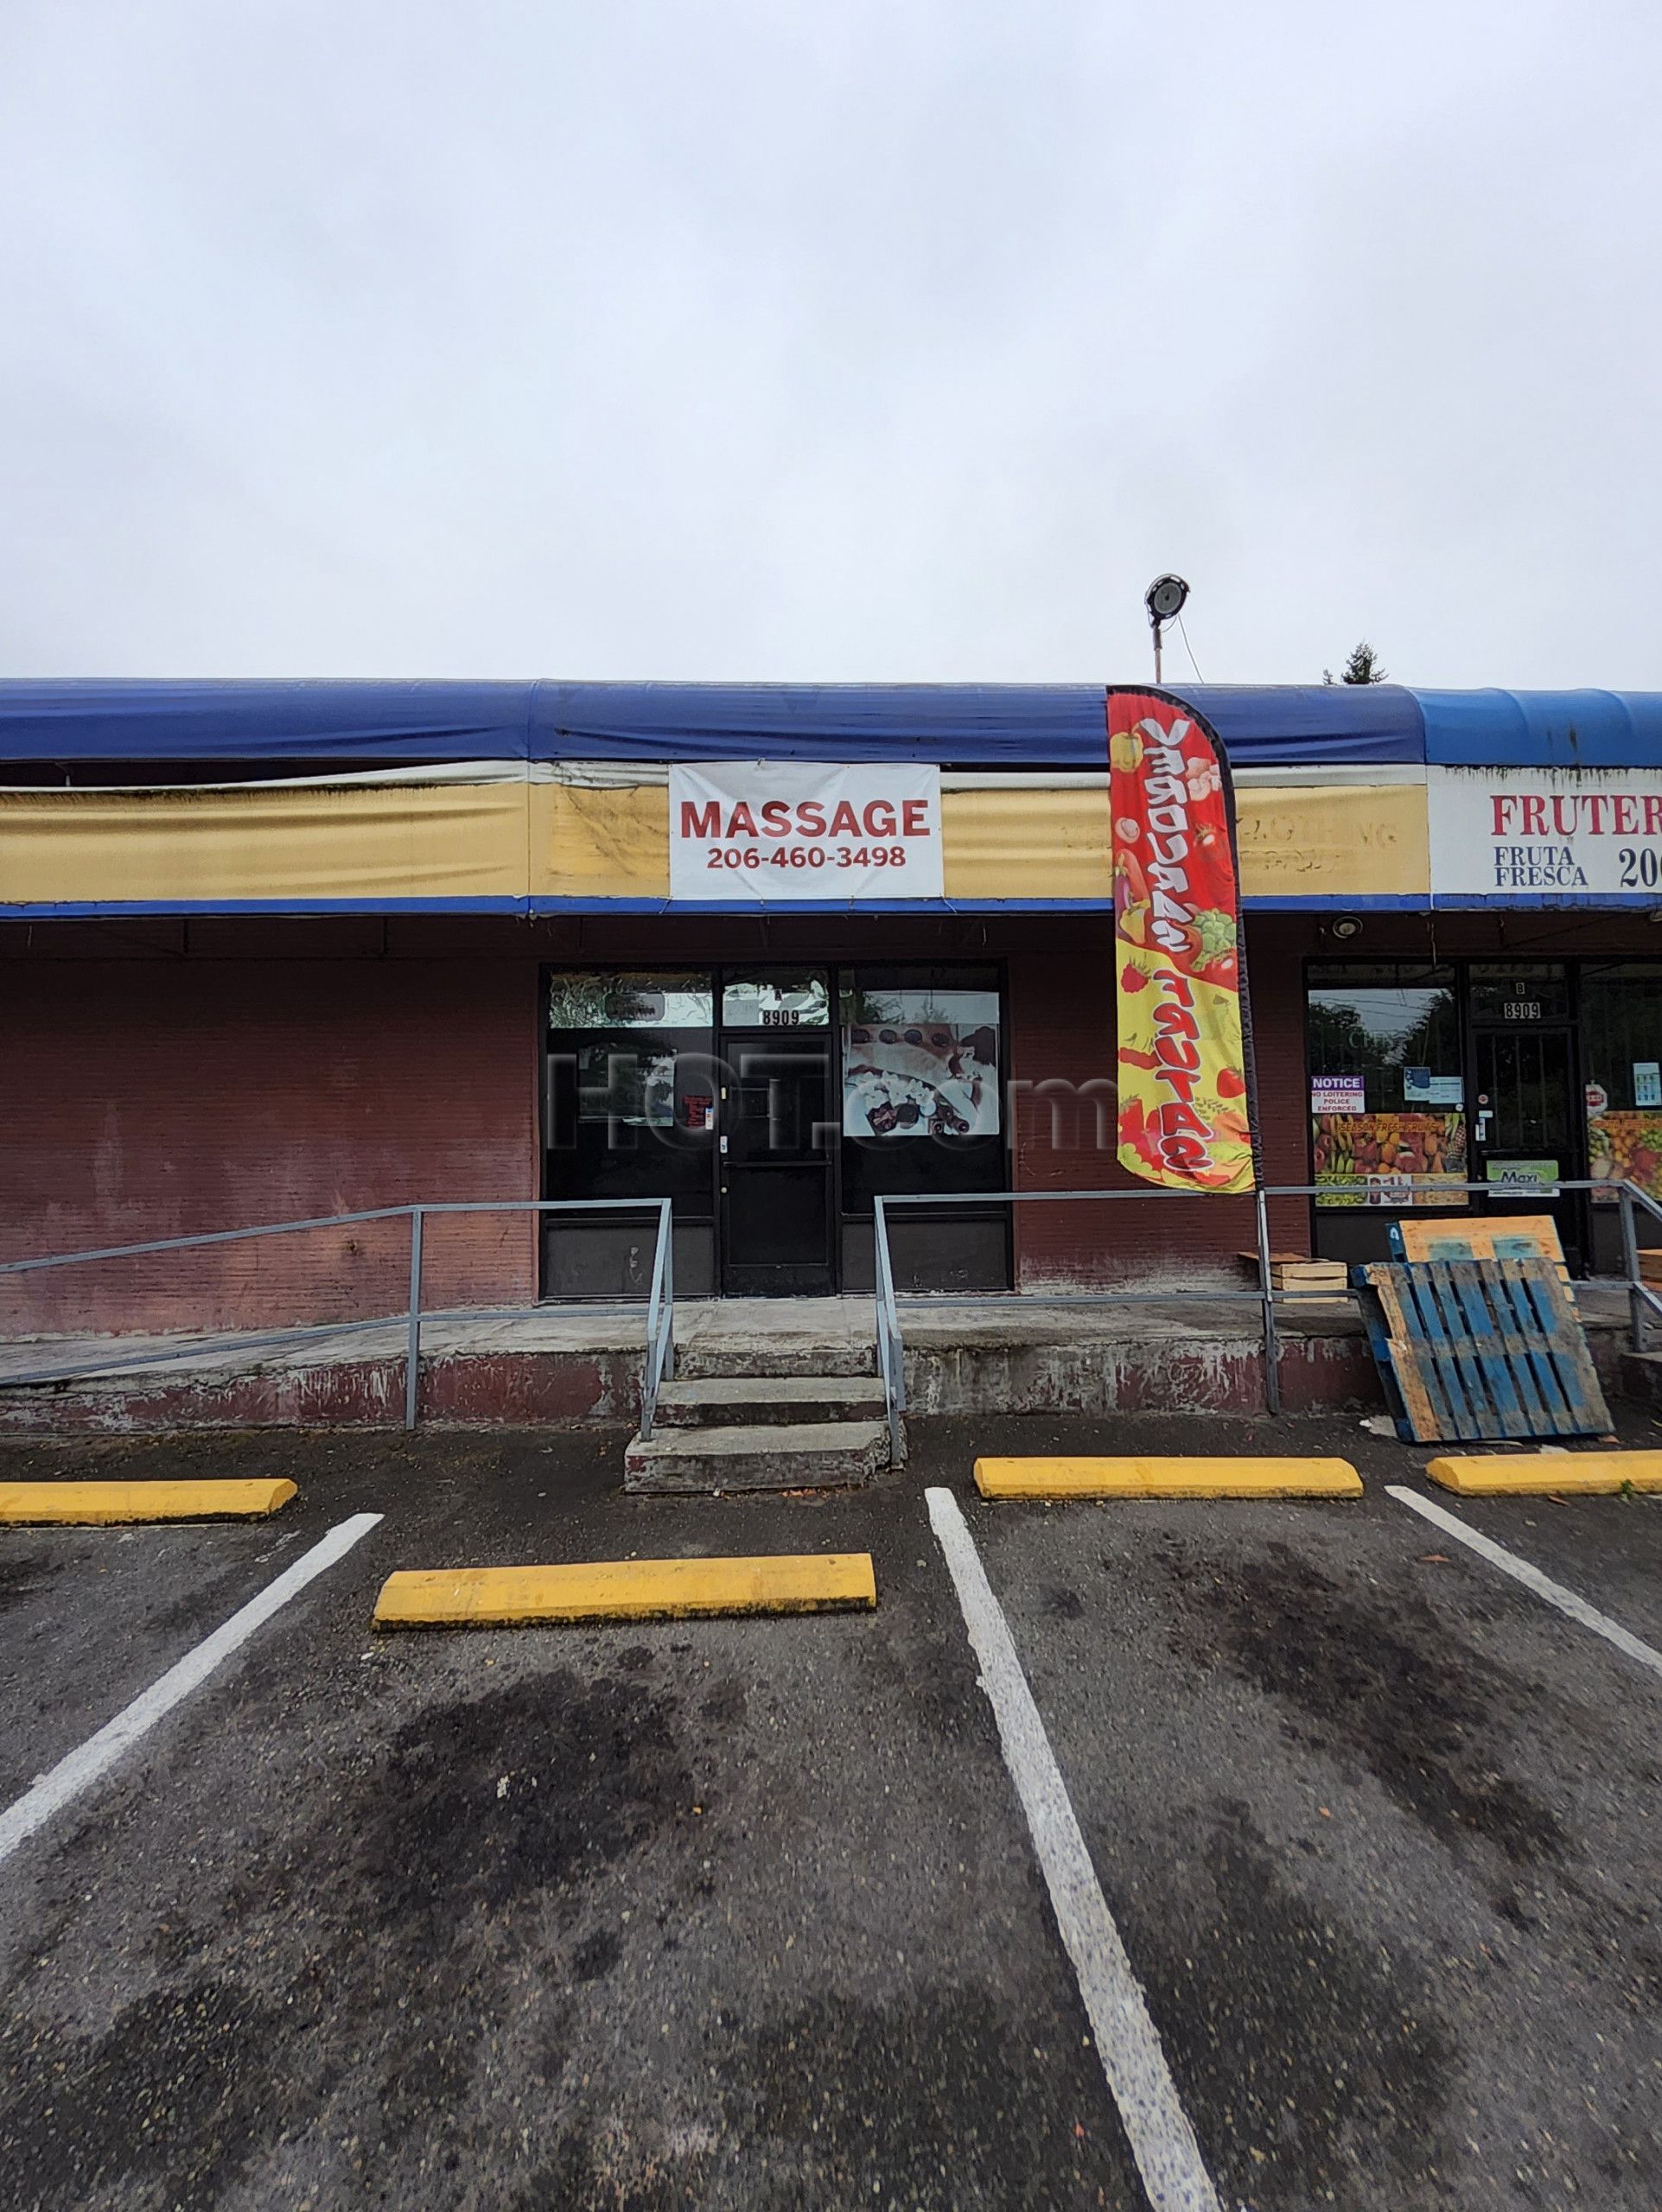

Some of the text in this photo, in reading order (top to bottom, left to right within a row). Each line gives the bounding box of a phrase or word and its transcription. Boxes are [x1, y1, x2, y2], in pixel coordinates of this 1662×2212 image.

[680, 799, 931, 839] MASSAGE
[706, 846, 907, 869] 206-460-3498
[1493, 846, 1575, 867] FRUTA
[1494, 867, 1589, 887] FRESCA
[1618, 848, 1662, 887] 20
[762, 1009, 799, 1025] 8909
[1506, 1003, 1539, 1018] 8909
[1313, 1077, 1360, 1088] NOTICE
